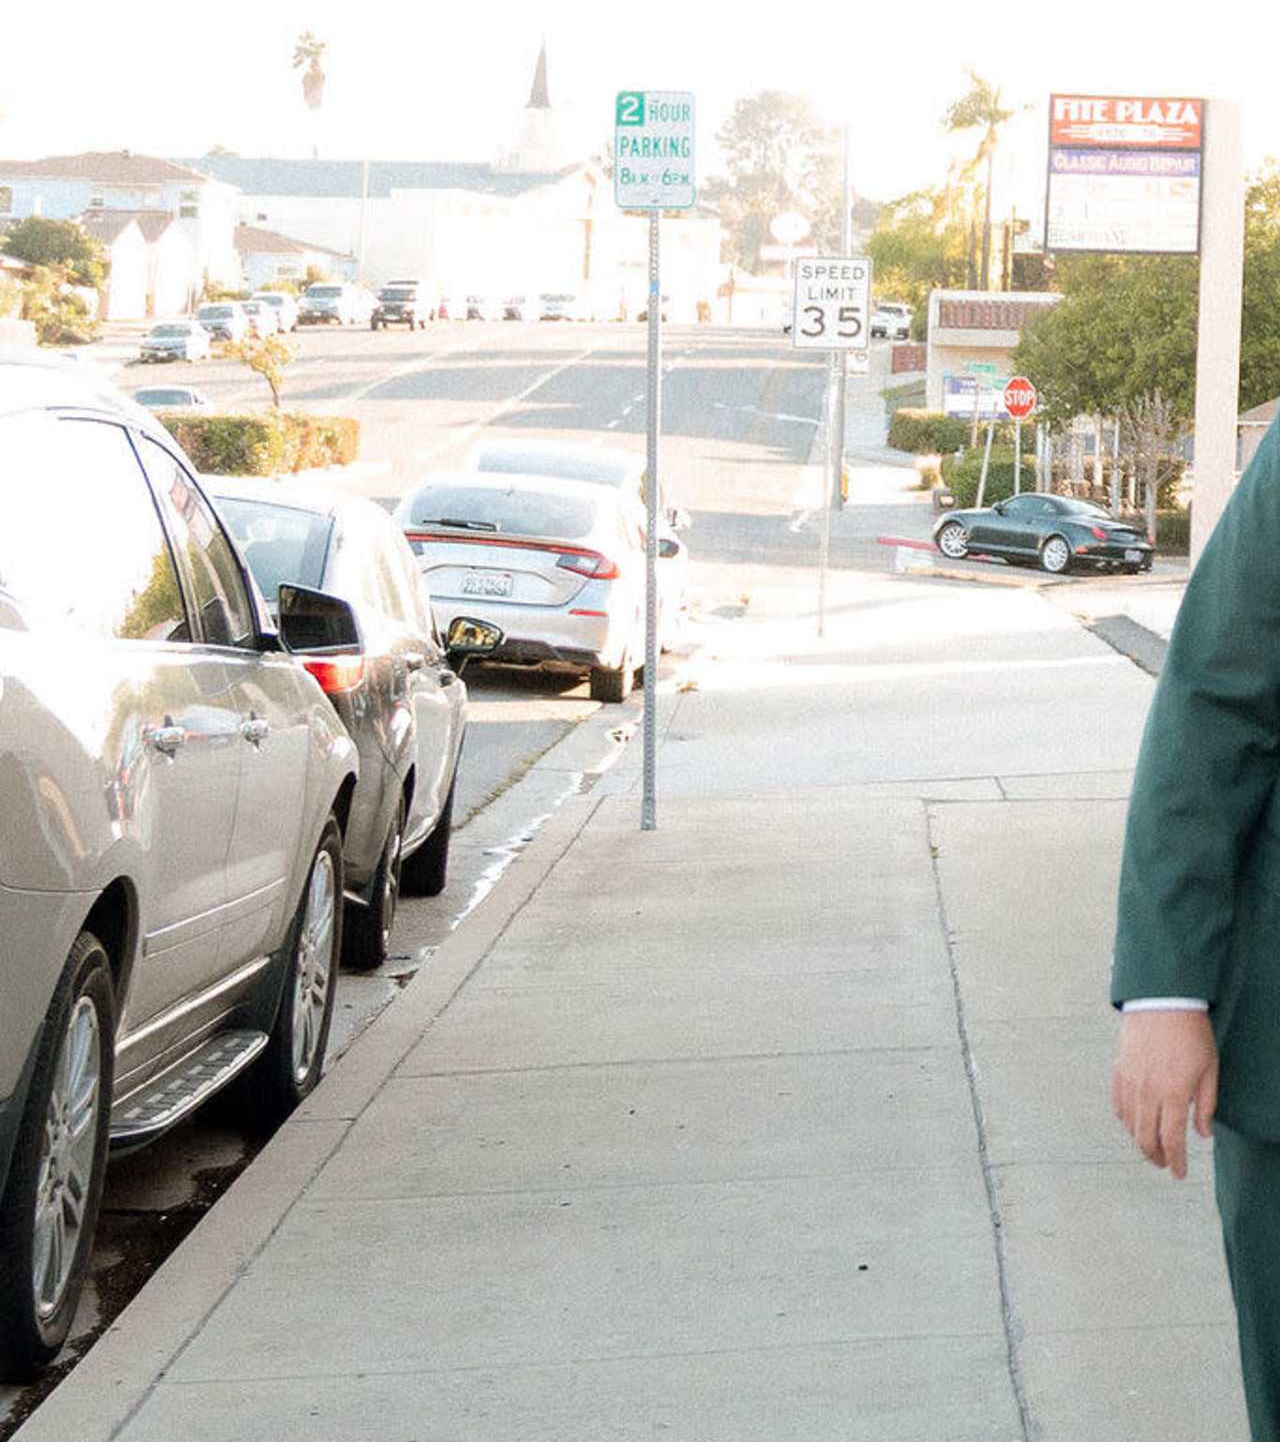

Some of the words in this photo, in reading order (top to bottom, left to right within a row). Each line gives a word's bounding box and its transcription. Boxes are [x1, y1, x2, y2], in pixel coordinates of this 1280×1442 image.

[621, 96, 640, 122] 2
[649, 104, 691, 122] HOUR
[1053, 98, 1108, 122] FITE
[1116, 102, 1198, 125] PLAZA
[620, 136, 691, 158] PARKING
[802, 265, 865, 280] SPEED
[808, 287, 855, 301] LIMIT
[801, 306, 862, 337] 35
[1004, 390, 1034, 406] STOP
